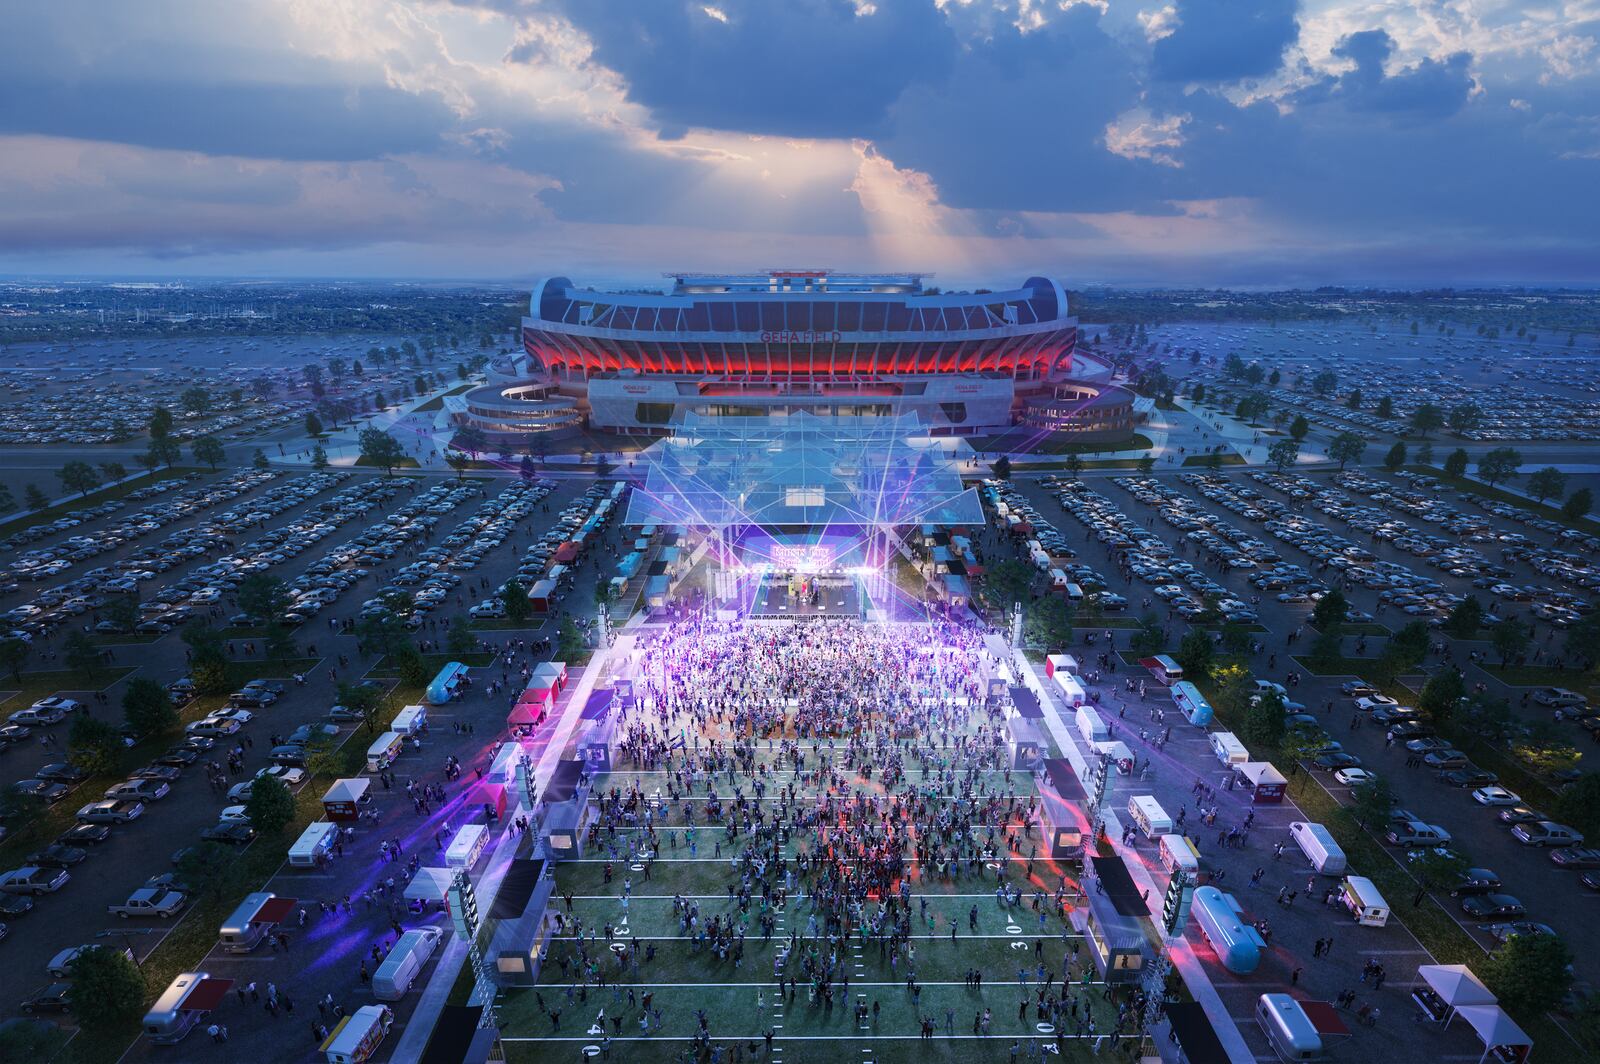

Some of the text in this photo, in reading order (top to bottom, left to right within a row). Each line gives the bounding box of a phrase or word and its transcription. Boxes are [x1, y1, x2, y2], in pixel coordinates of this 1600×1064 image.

[761, 331, 841, 343] GEHA FIELD
[609, 926, 631, 952] 30
[1005, 925, 1029, 951] 30
[581, 1024, 606, 1057] 40
